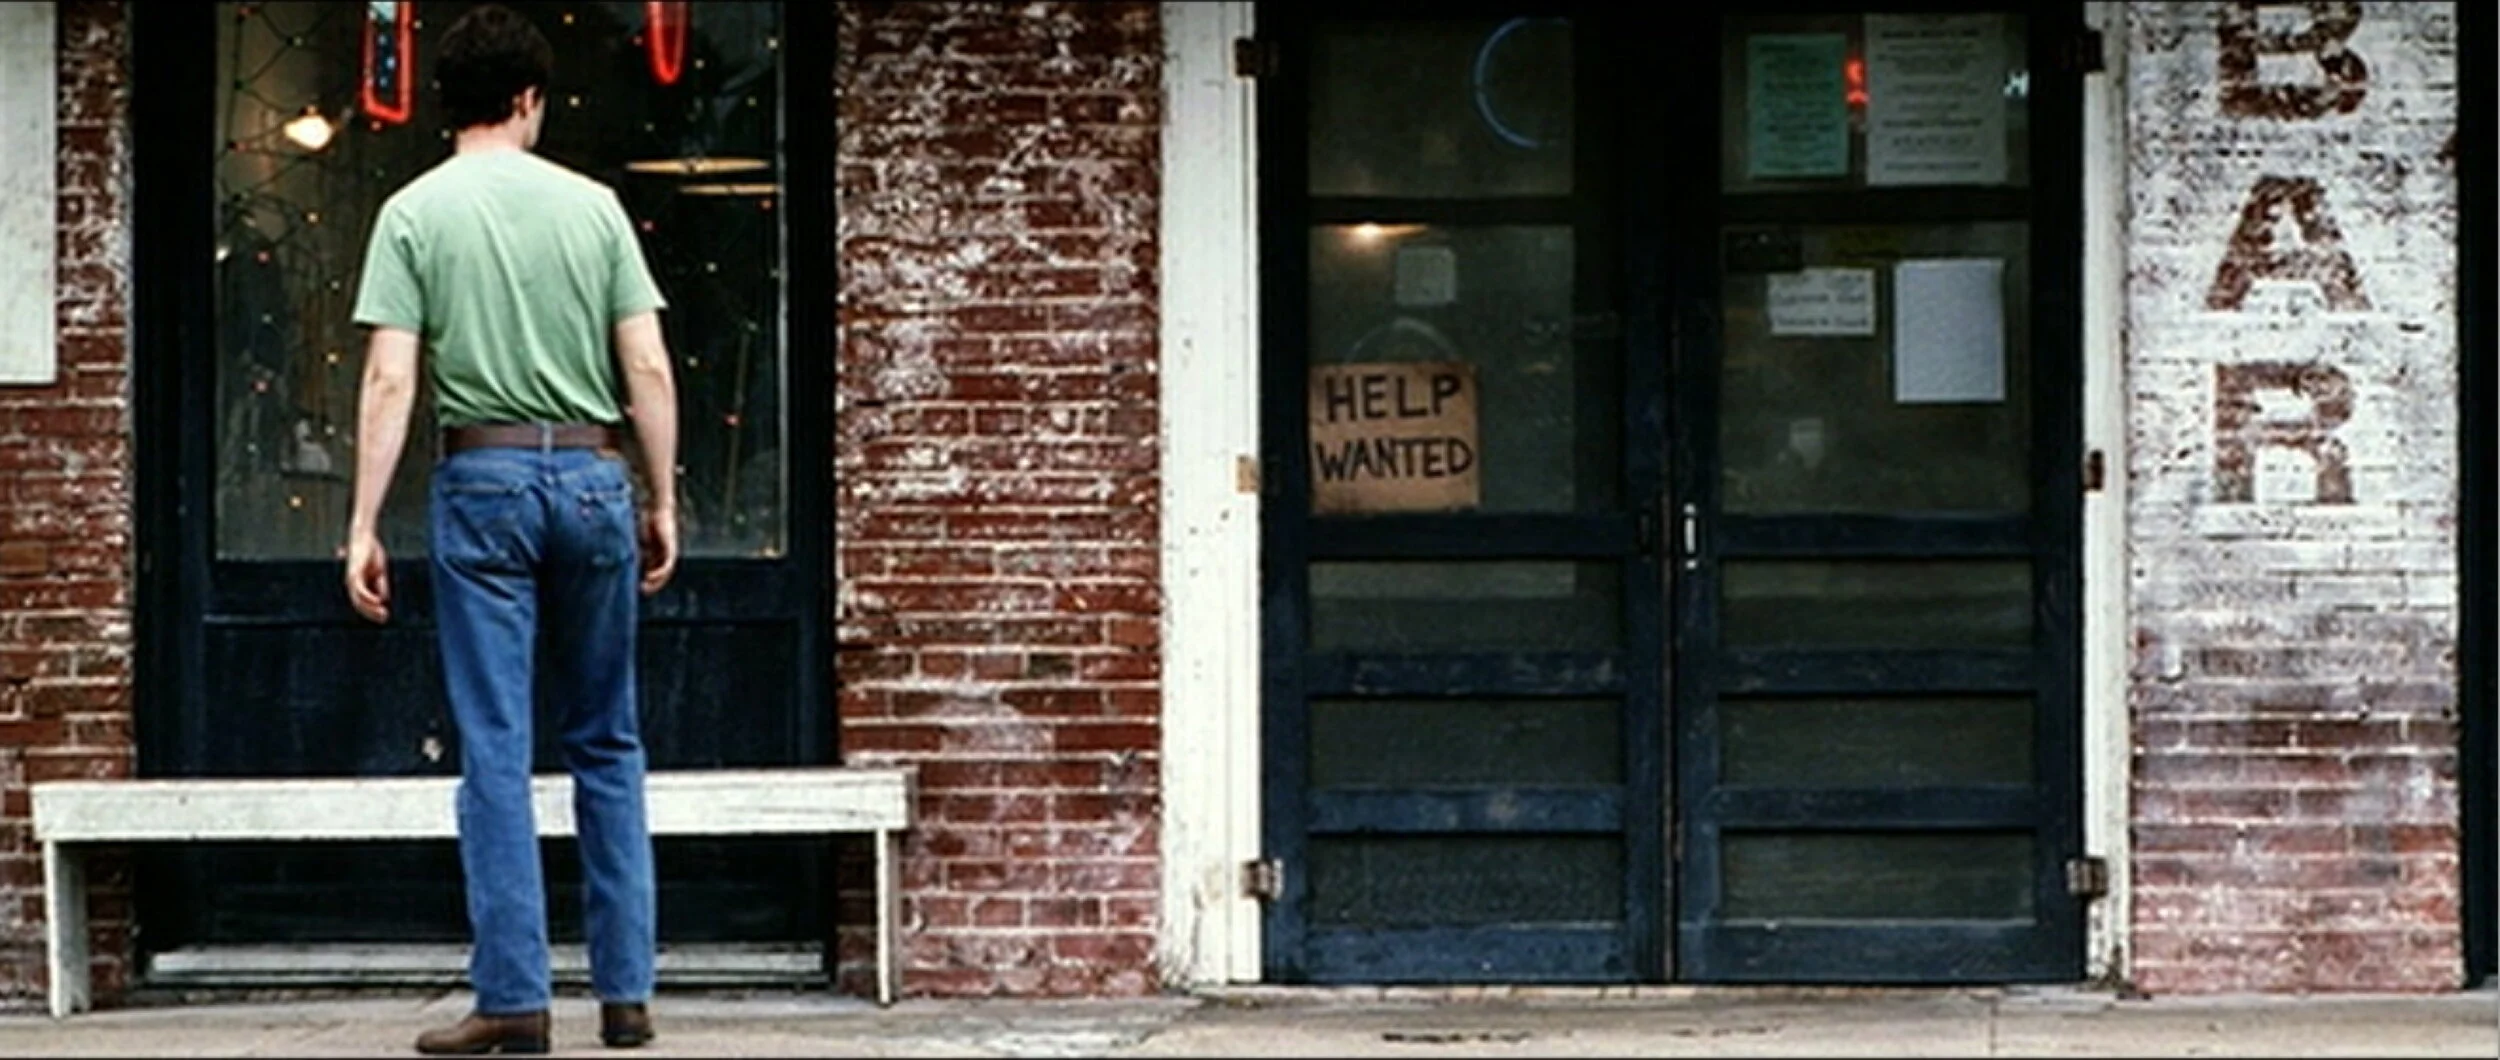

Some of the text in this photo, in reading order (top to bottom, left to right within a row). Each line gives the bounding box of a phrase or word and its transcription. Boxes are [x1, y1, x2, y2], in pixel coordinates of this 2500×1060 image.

[2205, 1, 2374, 504] BAR
[1325, 374, 1461, 422] HELP
[1316, 436, 1474, 482] WANTED
